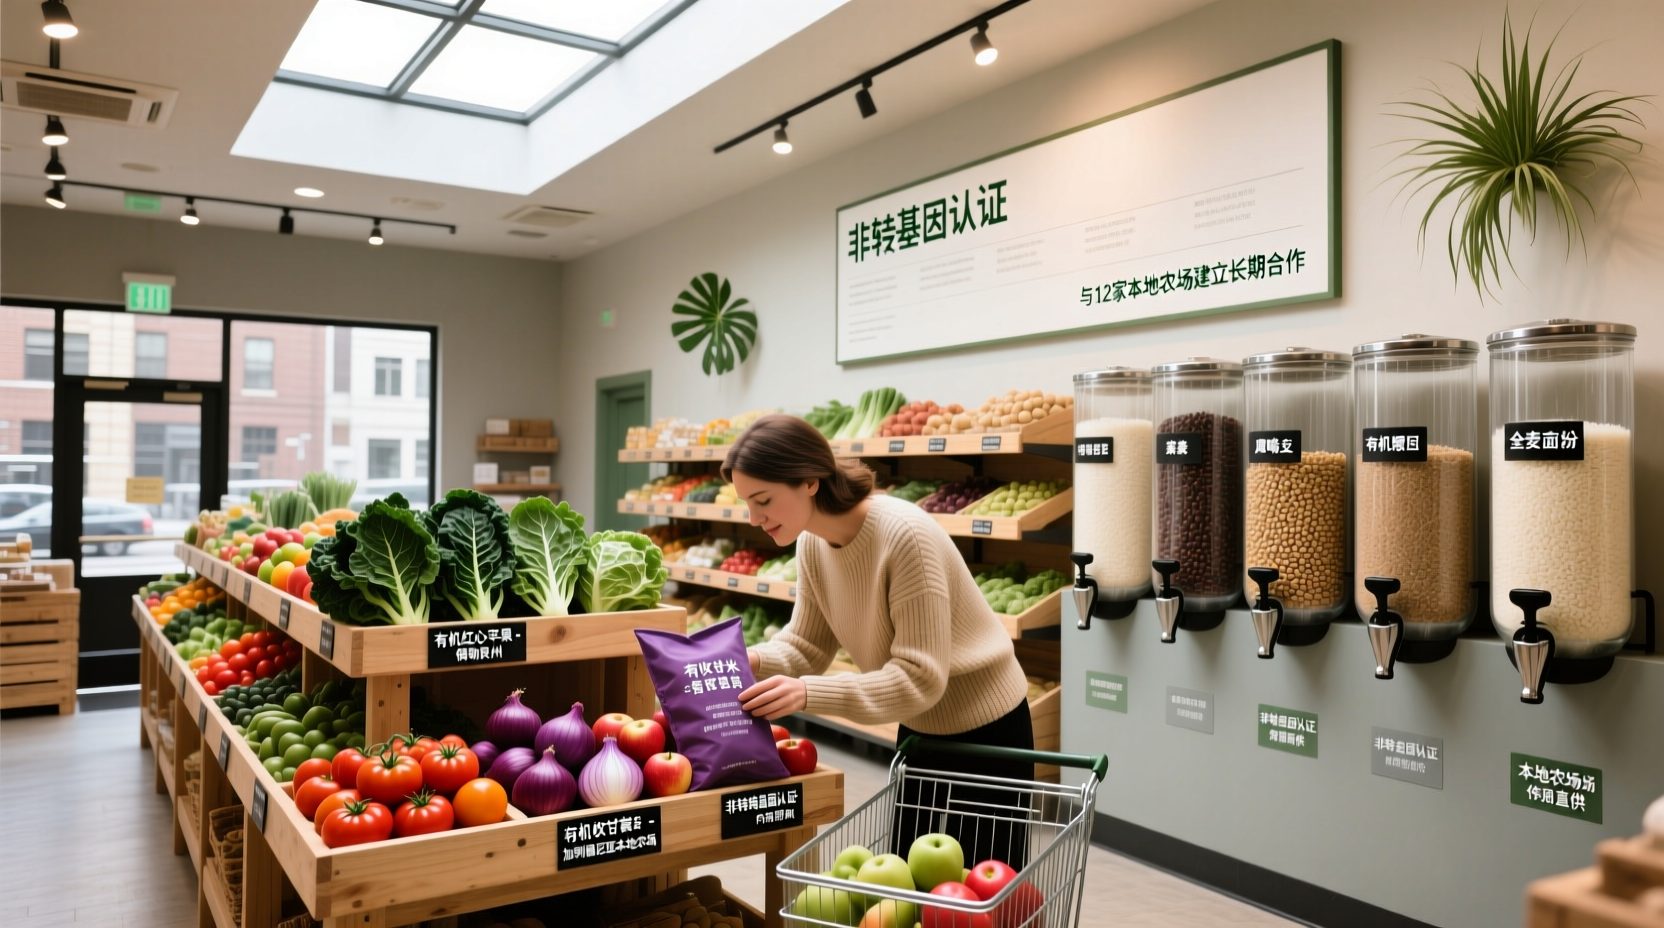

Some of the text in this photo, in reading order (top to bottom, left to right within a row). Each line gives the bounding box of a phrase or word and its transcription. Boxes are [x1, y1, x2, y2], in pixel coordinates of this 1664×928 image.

[848, 179, 1008, 263] 非转基因认证
[1080, 247, 1306, 306] 与12家本地农场建立长期合作
